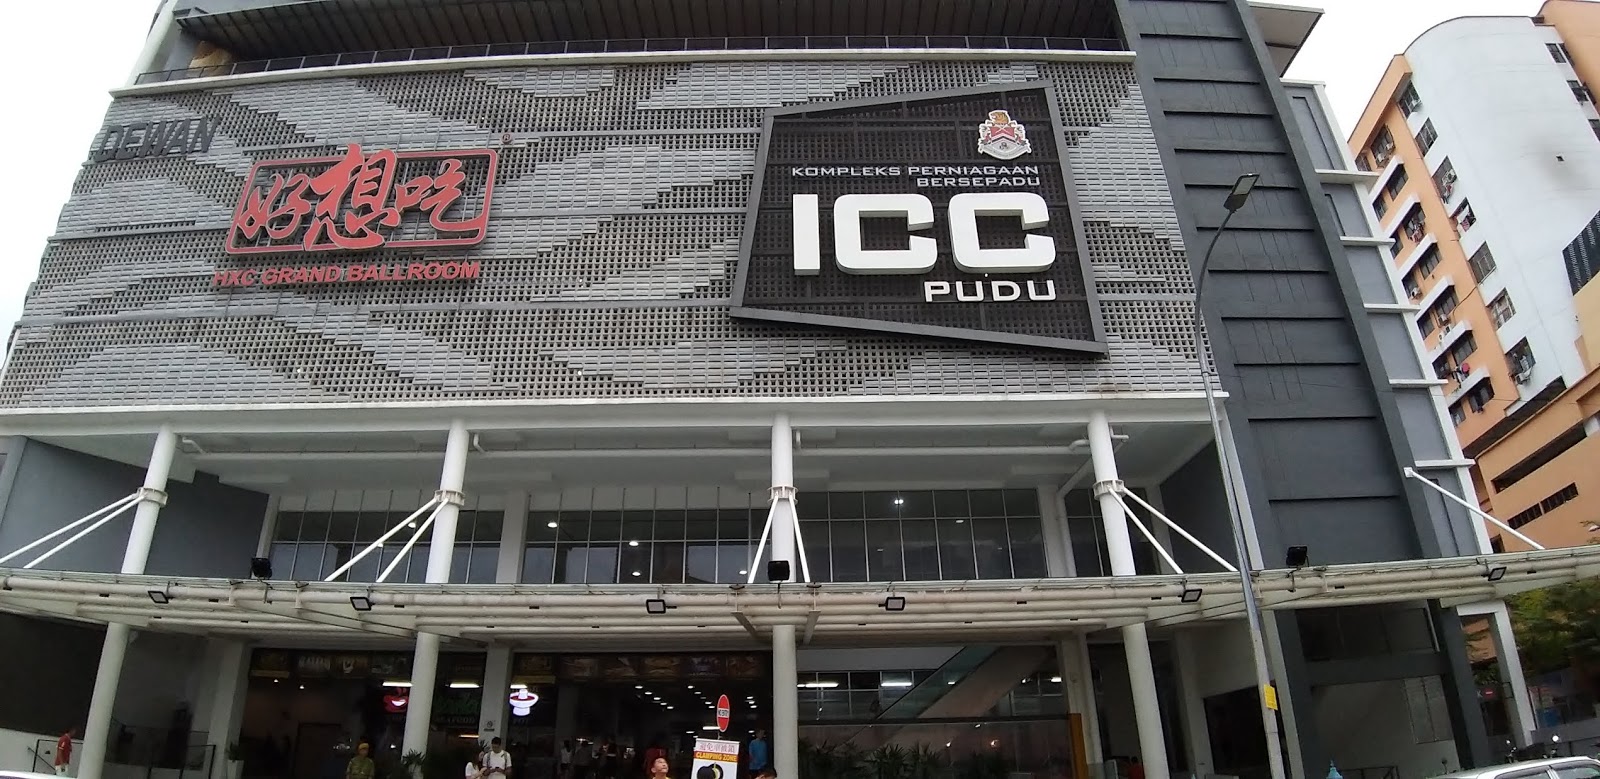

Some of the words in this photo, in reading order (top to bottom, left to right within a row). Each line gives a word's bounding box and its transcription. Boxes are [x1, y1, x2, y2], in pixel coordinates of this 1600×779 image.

[94, 116, 217, 162] DEWAN
[792, 166, 901, 177] KOMPLEKS
[908, 165, 1039, 176] PERNIAGAAN
[917, 177, 1040, 187] BERSEPADU
[236, 144, 483, 250] 好想吃
[792, 192, 1056, 275] ICC
[212, 268, 257, 286] HXC
[261, 264, 341, 285] GRAND
[347, 261, 480, 281] BALLROOM
[924, 280, 1057, 302] PUDU
